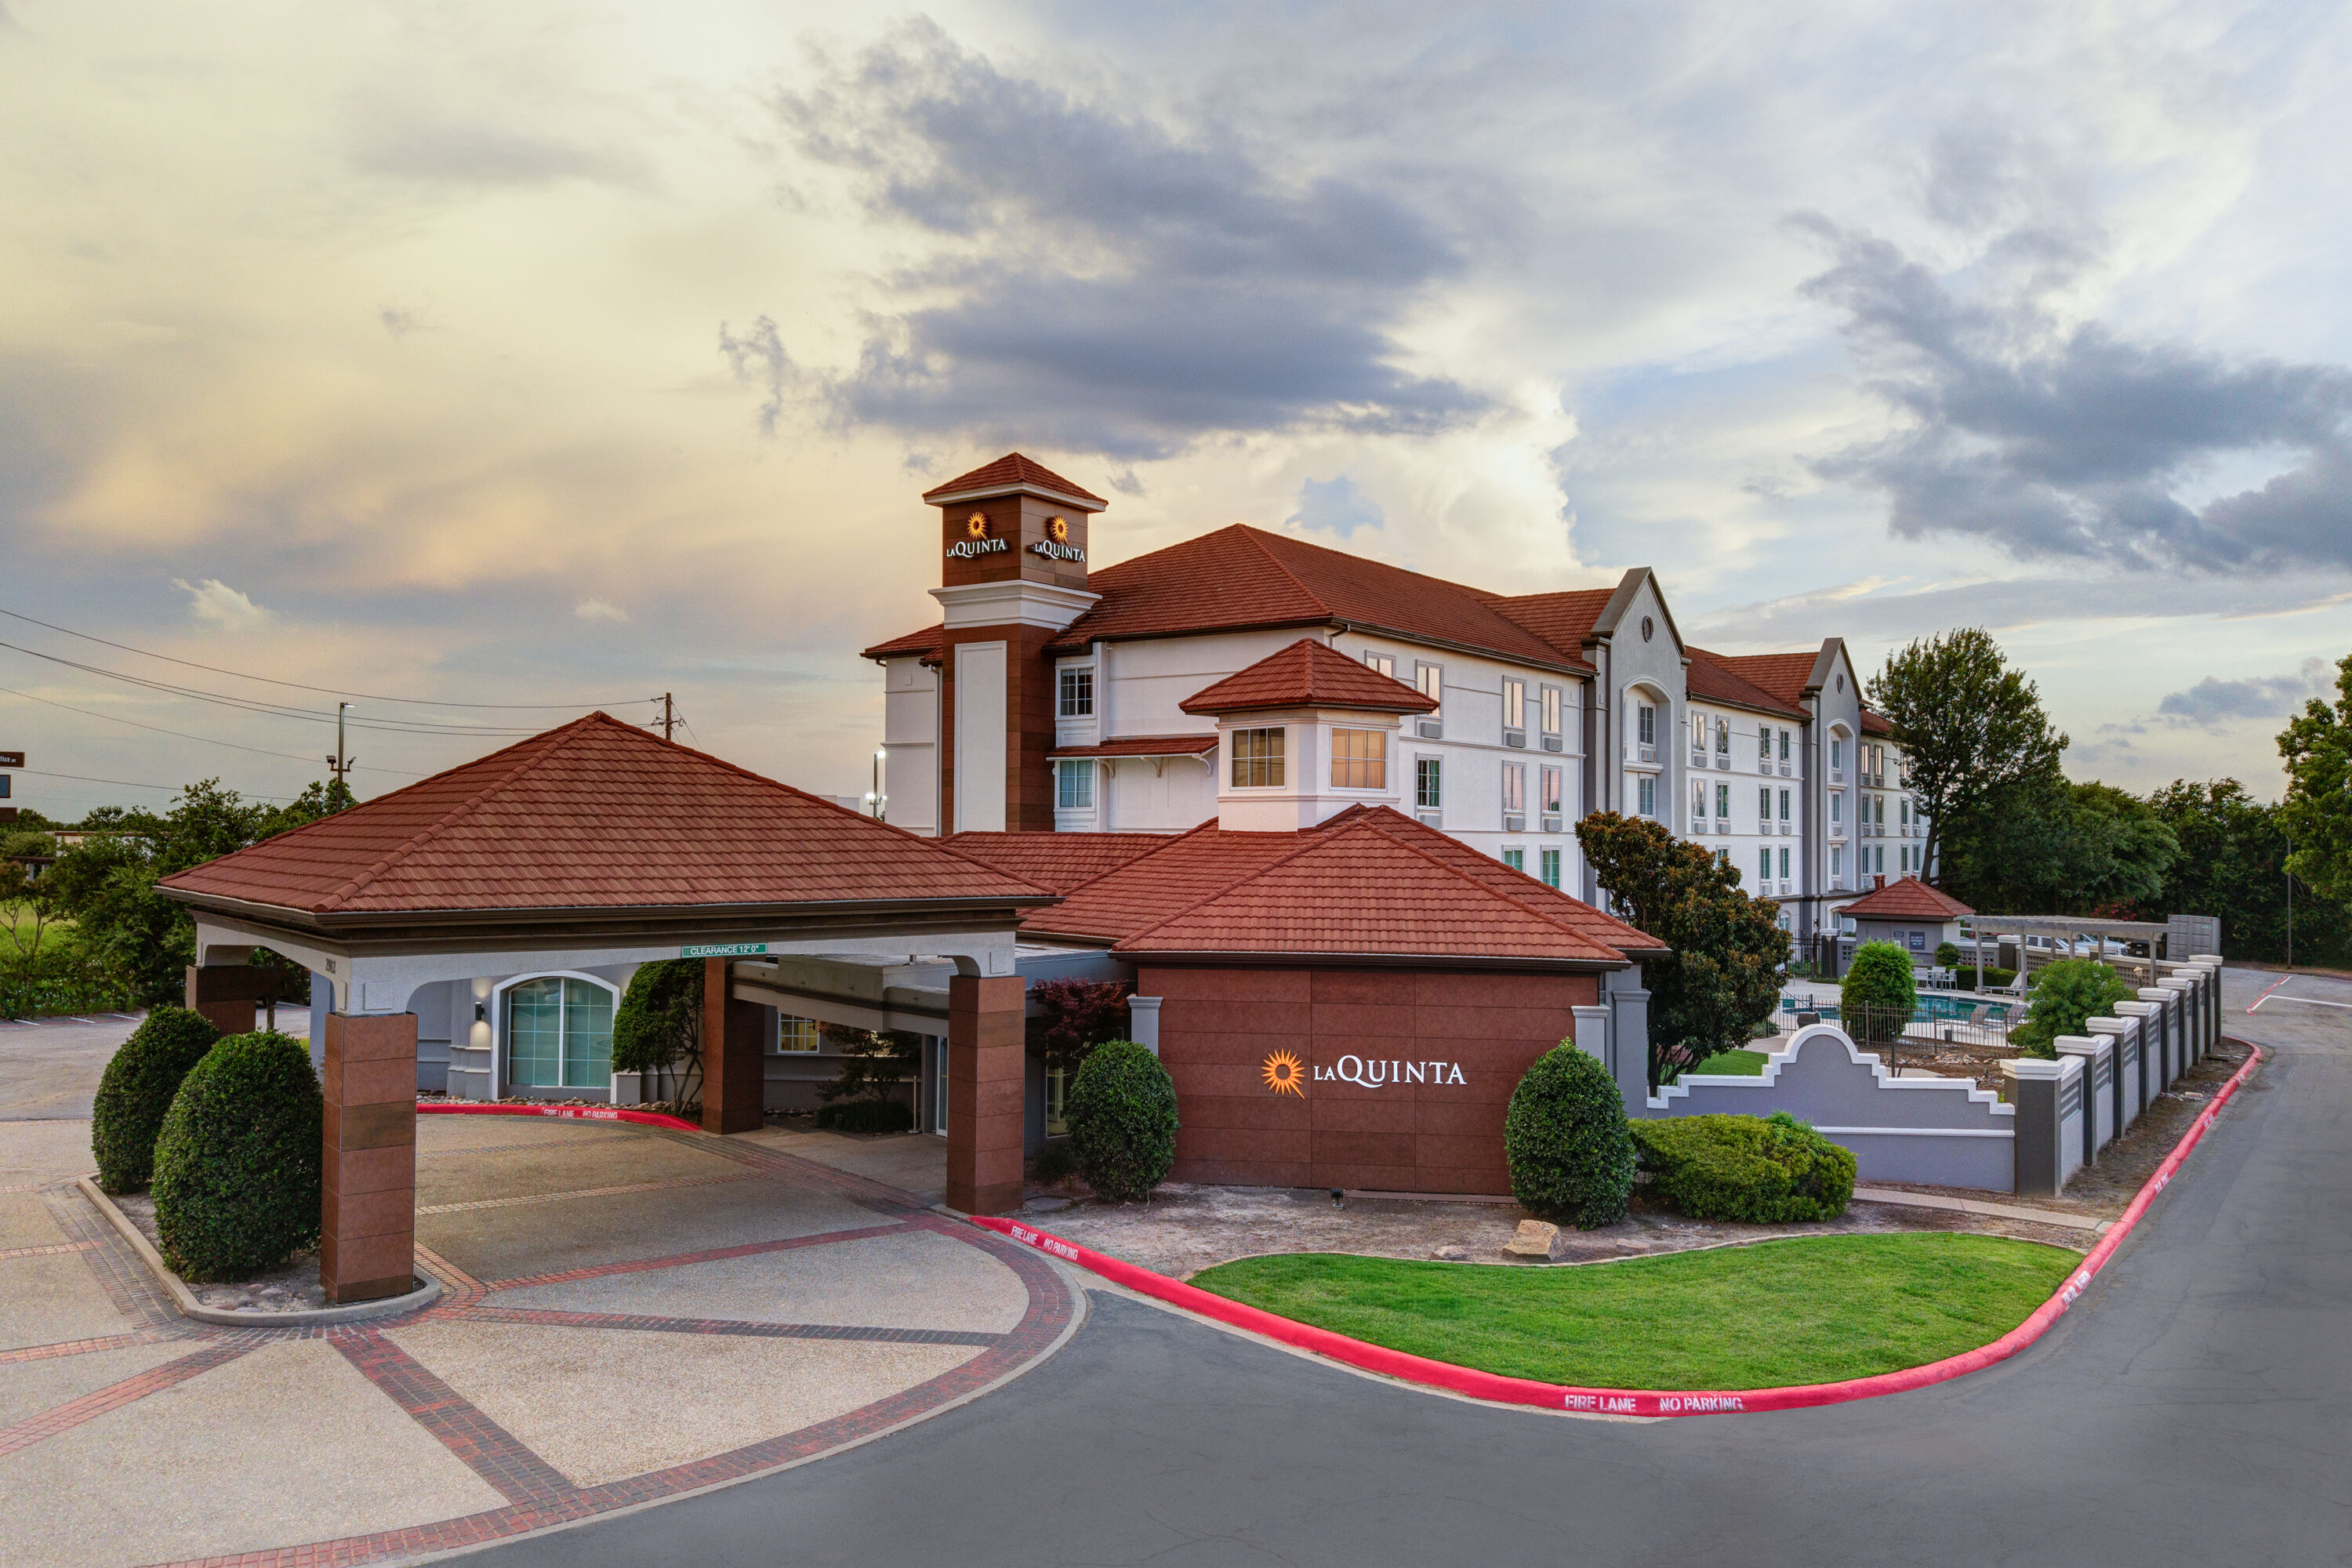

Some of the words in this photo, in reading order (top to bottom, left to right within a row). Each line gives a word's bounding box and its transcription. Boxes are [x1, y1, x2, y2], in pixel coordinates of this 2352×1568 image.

[690, 946, 737, 956] CLEARANCE
[544, 1109, 557, 1117] FIRE
[558, 1109, 575, 1118] LANE
[592, 1111, 618, 1120] PARKING
[1011, 1225, 1024, 1240] FIRE
[1022, 1229, 1038, 1245] LANE
[1044, 1238, 1054, 1250] NO
[1053, 1242, 1078, 1260] PARKING
[1565, 1394, 1596, 1409] FIRE
[1599, 1396, 1636, 1411] LANE
[1660, 1397, 1681, 1412] NO
[1685, 1396, 1744, 1411] PARKING
